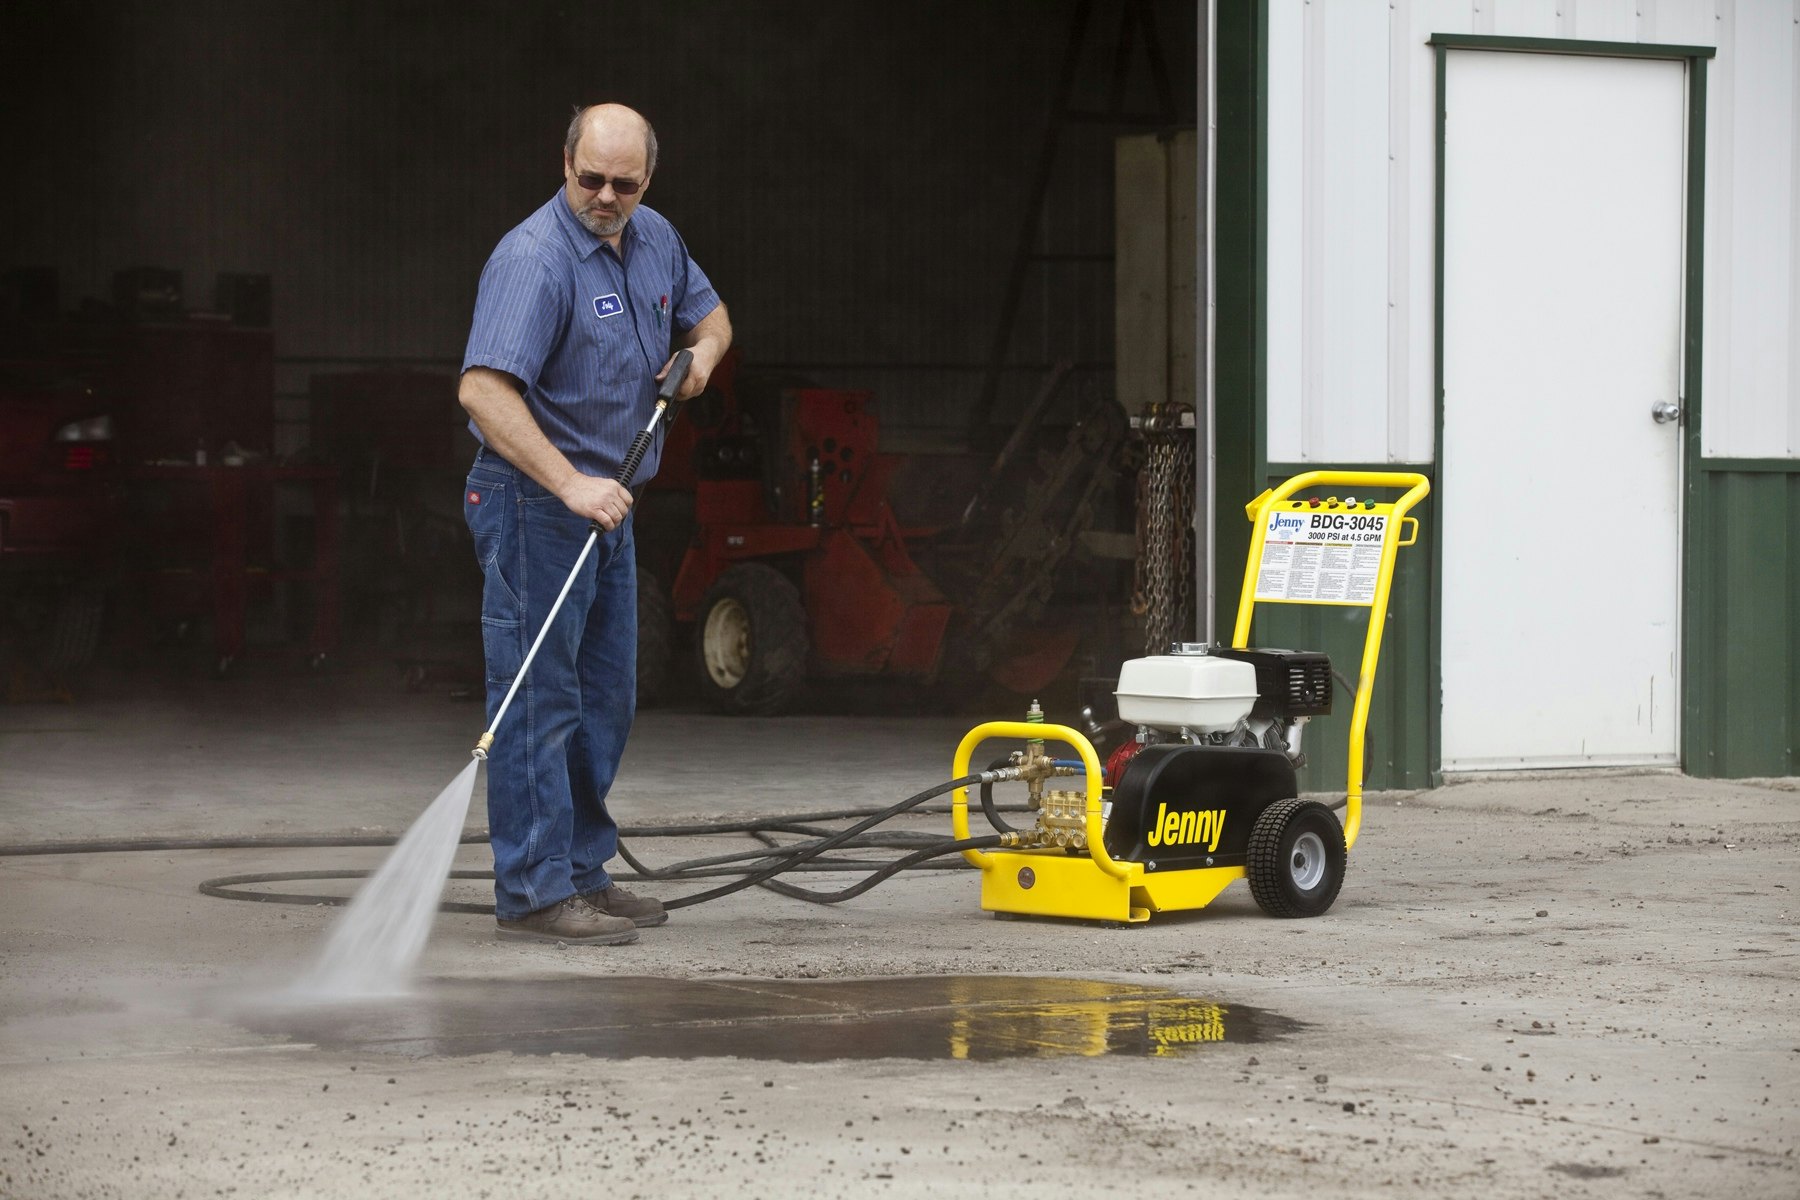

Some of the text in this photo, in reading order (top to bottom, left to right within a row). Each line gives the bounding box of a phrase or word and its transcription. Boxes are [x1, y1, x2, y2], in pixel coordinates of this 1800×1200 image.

[1269, 512, 1385, 532] Jenny BDG-3045
[1308, 532, 1382, 542] 3000 PSI at 4.5 GPM
[1148, 802, 1226, 852] Jenny
